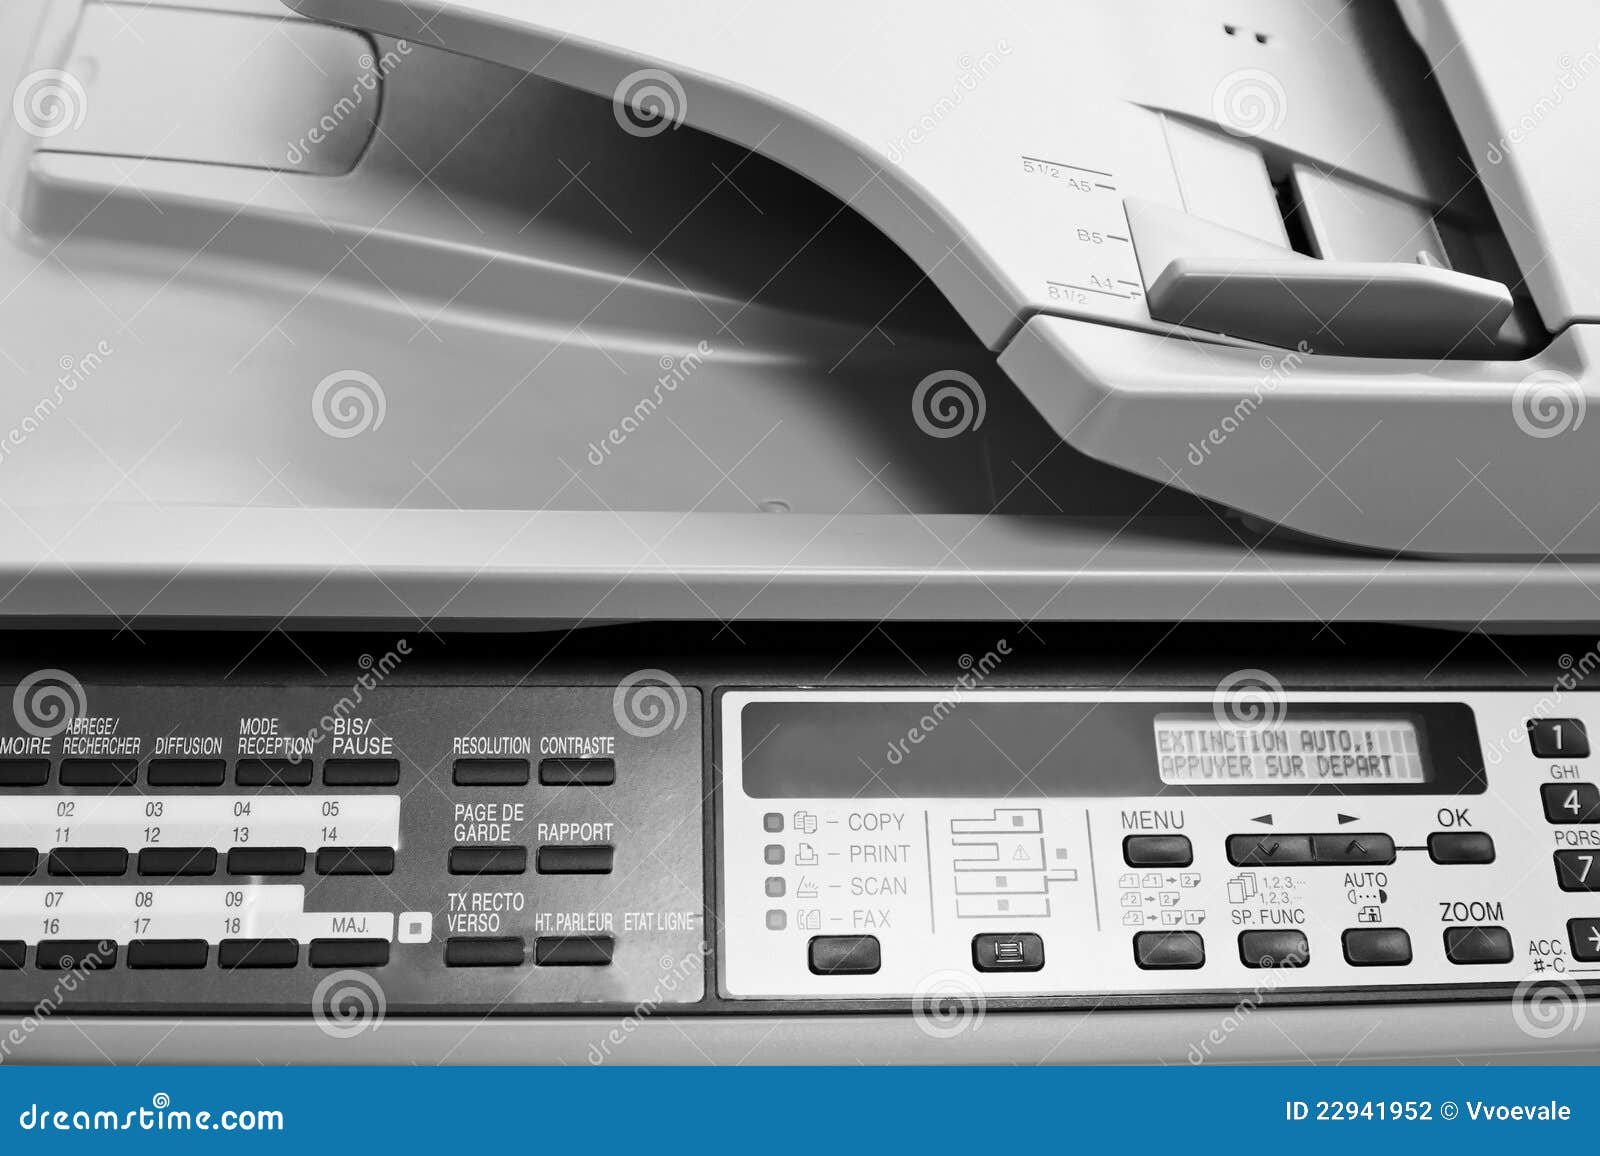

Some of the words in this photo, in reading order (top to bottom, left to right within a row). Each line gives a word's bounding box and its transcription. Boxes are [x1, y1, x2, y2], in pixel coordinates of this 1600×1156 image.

[1070, 178, 1091, 192] A5
[1077, 229, 1103, 244] B5
[1090, 275, 1112, 289] A4
[66, 718, 119, 735] ABREGE/
[240, 718, 278, 735] MODE
[334, 718, 372, 735] BIS/
[453, 737, 531, 754] RESOLUTION
[540, 737, 615, 754] CONTRASTE
[1158, 730, 1288, 753] EXTINCTION
[1552, 724, 1562, 750] 1
[0, 737, 52, 755] MOIRE
[63, 737, 140, 755] RECHERCHER
[155, 737, 222, 755] DIFFUSION
[238, 737, 314, 755] RECEPTION
[332, 737, 393, 755] PAUSE
[1161, 755, 1253, 778] APPUYER
[1266, 755, 1305, 778] SUR
[1316, 755, 1392, 778] DEPART
[1550, 765, 1580, 780] GHI
[57, 801, 75, 818] 02
[145, 801, 163, 818] 03
[233, 801, 251, 818] 04
[321, 801, 340, 818] 05
[1564, 789, 1581, 815] 4
[454, 804, 497, 822] PAGE
[503, 804, 524, 822] DE
[1121, 811, 1185, 830] MENU
[1437, 809, 1471, 828] OK
[848, 813, 905, 832] COPY
[55, 826, 70, 842] 11
[144, 826, 160, 842] 12
[232, 826, 249, 842] 13
[321, 826, 337, 842] 14
[454, 824, 511, 842] GARDE
[538, 823, 613, 841] RAPPORT
[1554, 831, 1600, 846] PQRS
[850, 844, 911, 863] PRINT
[1578, 855, 1594, 882] 7
[850, 877, 907, 896] SCAN
[1344, 873, 1388, 888] AUTO
[44, 892, 63, 908] 07
[135, 892, 153, 908] 08
[225, 892, 243, 908] 09
[448, 893, 467, 911] TX
[472, 892, 525, 911] RECTO
[853, 910, 892, 929] FAX
[1231, 909, 1256, 925] SP.
[1260, 909, 1305, 925] FUNC
[1441, 902, 1504, 922] ZOOM
[43, 918, 60, 934] 16
[134, 918, 151, 934] 17
[224, 918, 241, 934] 18
[332, 917, 369, 934] MAJ.
[447, 914, 500, 932] VERSO
[624, 912, 653, 931] ETAT
[657, 912, 694, 931] LIGNE
[1529, 940, 1566, 956] ACC.
[1534, 958, 1566, 974] #-C
